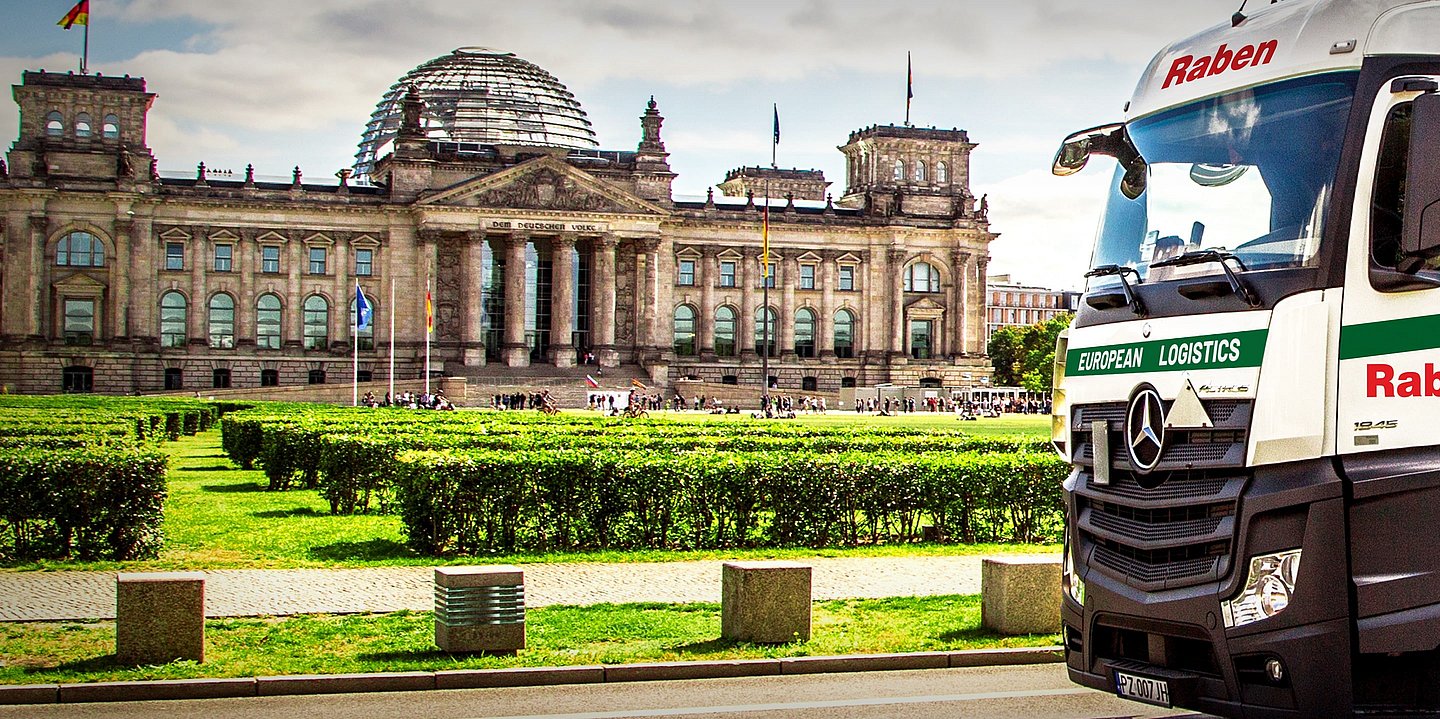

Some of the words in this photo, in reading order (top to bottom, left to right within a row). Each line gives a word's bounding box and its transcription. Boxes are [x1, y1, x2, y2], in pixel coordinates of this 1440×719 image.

[1161, 39, 1278, 90] Raben
[518, 222, 566, 230] DEUTSCHEN
[1077, 347, 1144, 371] EUROPEAN
[1158, 338, 1241, 366] LOGISTICS
[1120, 674, 1136, 696] PZ
[1136, 678, 1154, 699] 007
[1156, 682, 1169, 702] JH
